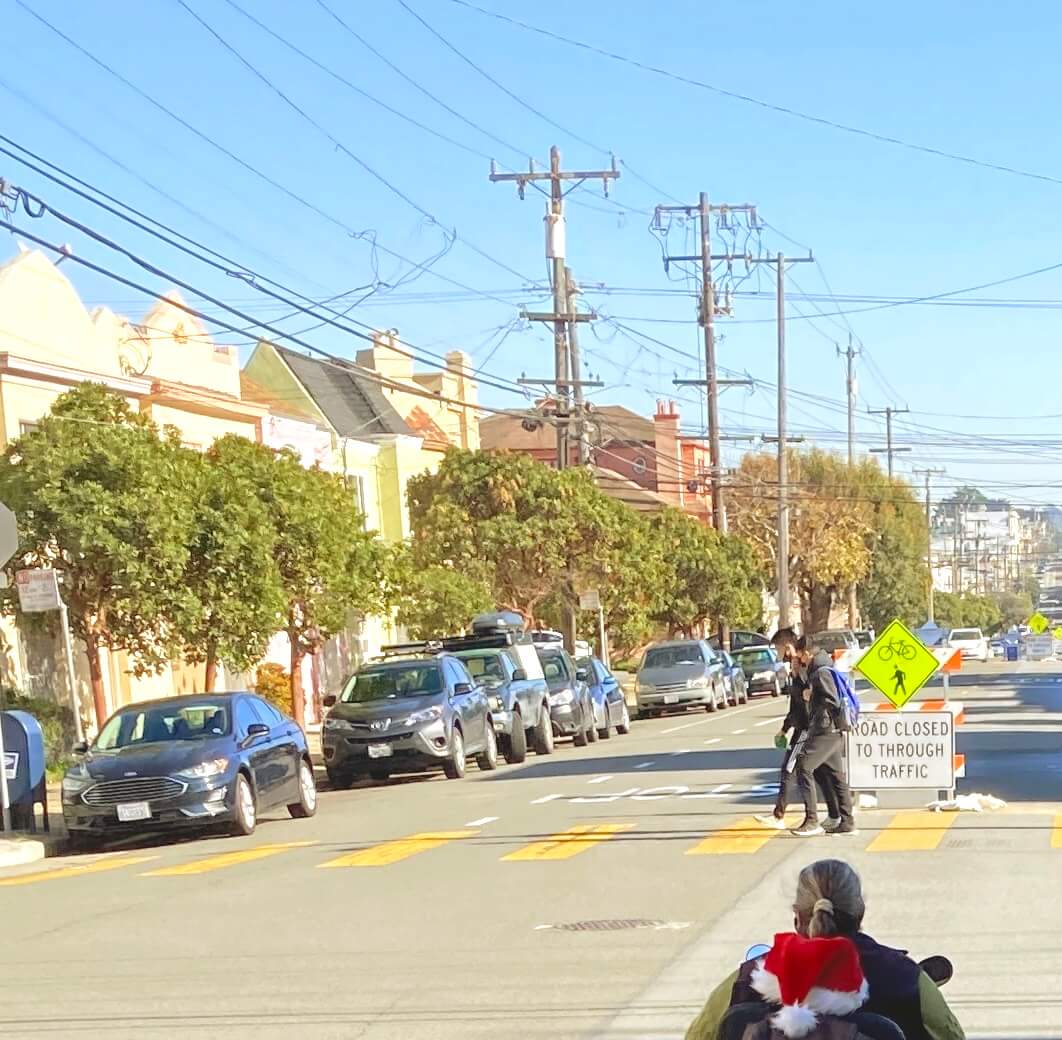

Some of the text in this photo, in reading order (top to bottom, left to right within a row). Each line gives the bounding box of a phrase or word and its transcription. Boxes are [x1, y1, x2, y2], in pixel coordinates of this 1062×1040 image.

[894, 721, 949, 737] CLOSED
[856, 743, 944, 758] TO THROUGH
[872, 764, 929, 779] TRAFFIC
